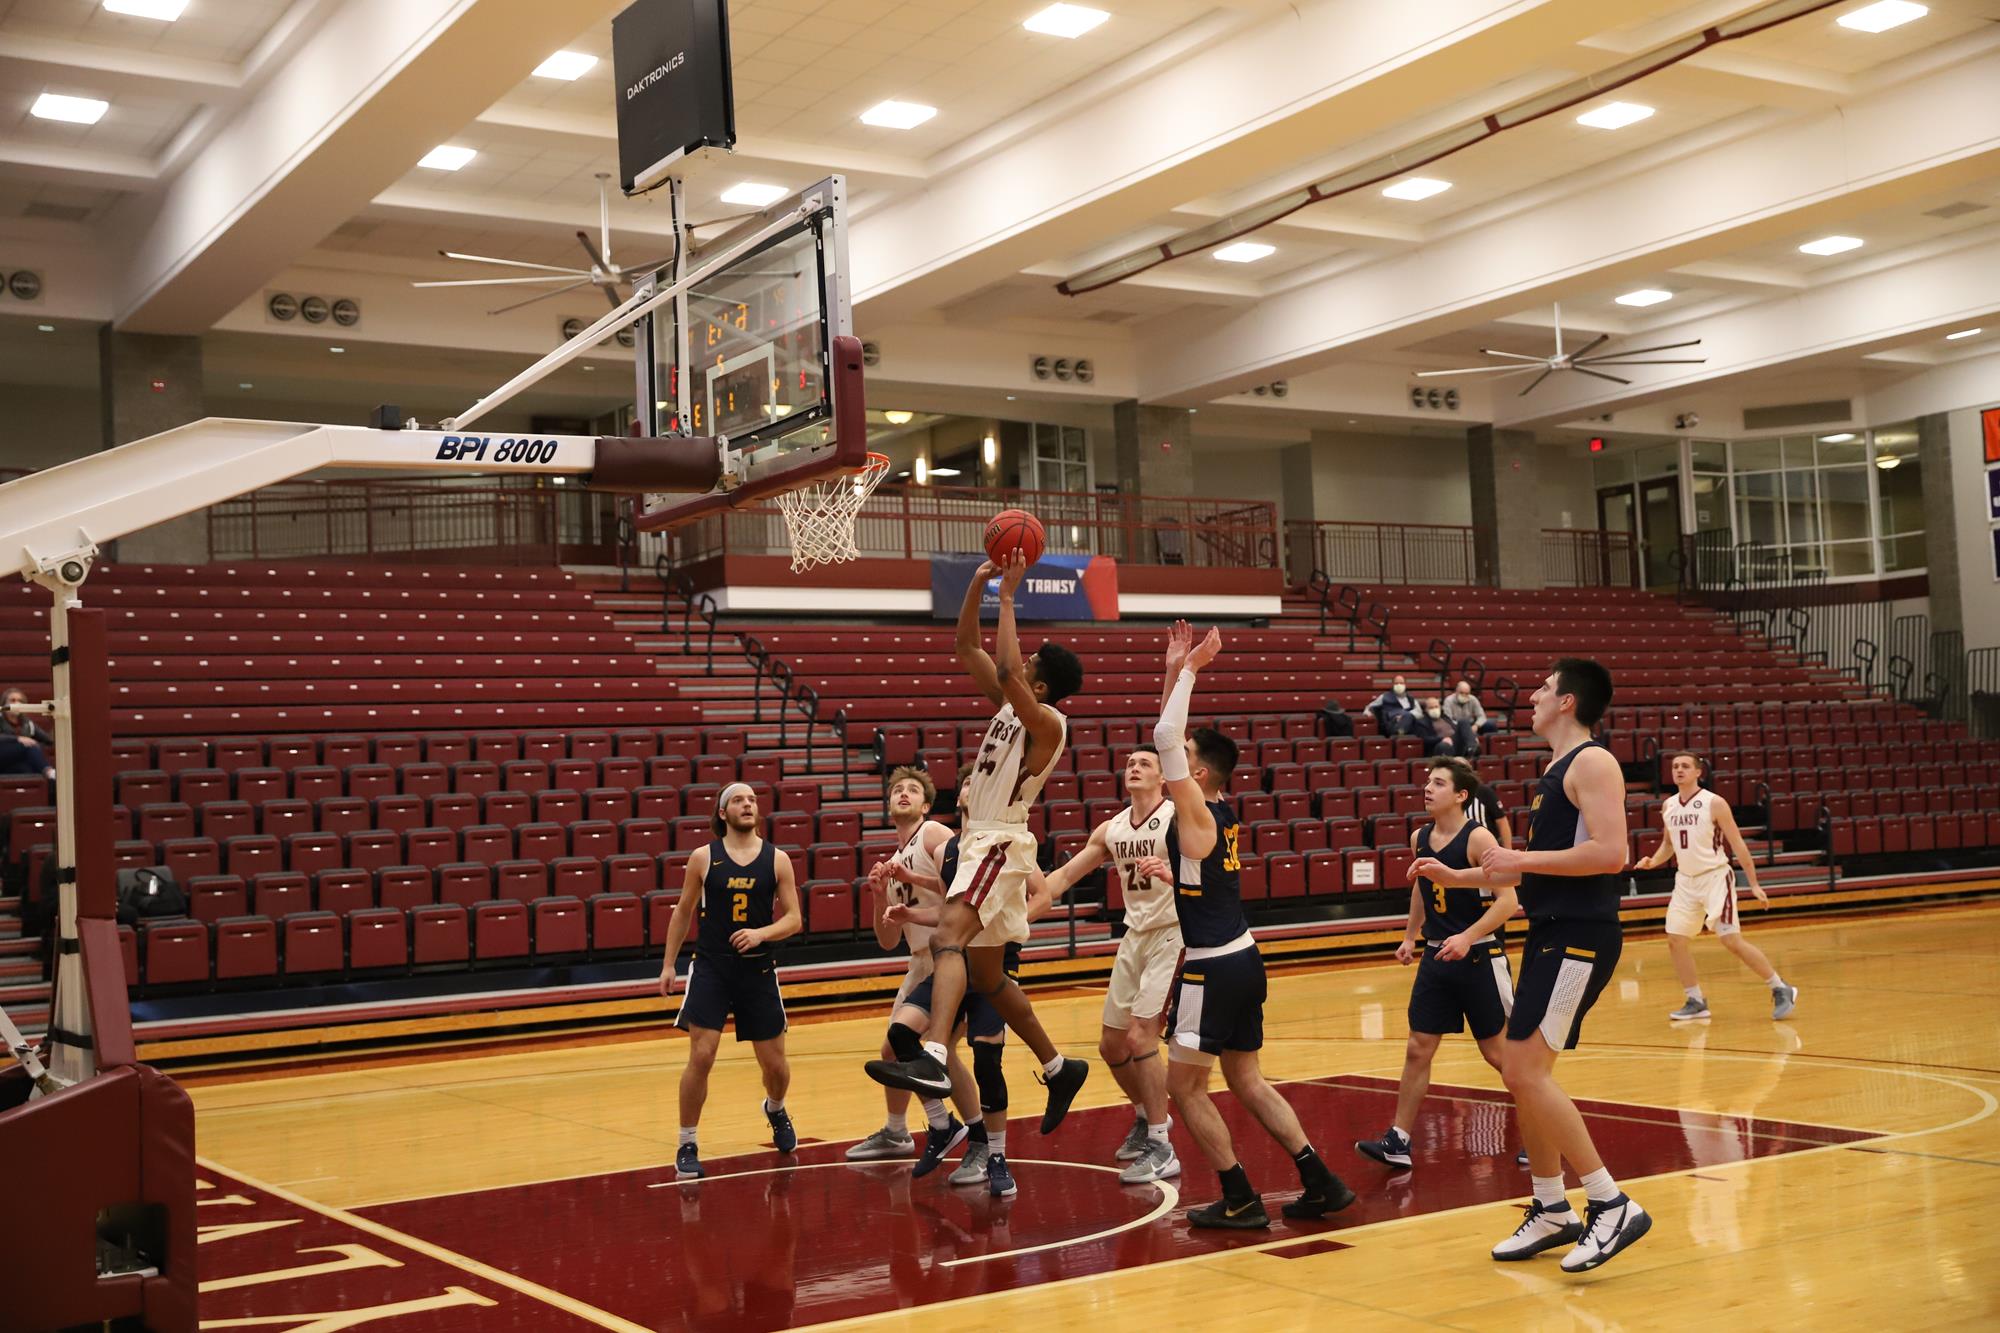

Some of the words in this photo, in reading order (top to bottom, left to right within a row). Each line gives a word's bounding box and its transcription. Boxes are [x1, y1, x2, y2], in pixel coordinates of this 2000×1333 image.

[626, 51, 685, 100] DAKTRONICS
[435, 436, 490, 461] BPI
[493, 438, 558, 464] 8000
[1026, 579, 1076, 594] TRANSY
[1670, 814, 1700, 827] TRANSY
[1114, 839, 1156, 859] TRANSY
[1679, 829, 1688, 849] 0
[726, 877, 756, 889] MSJ
[732, 893, 748, 922] 2
[1432, 883, 1447, 913] 3
